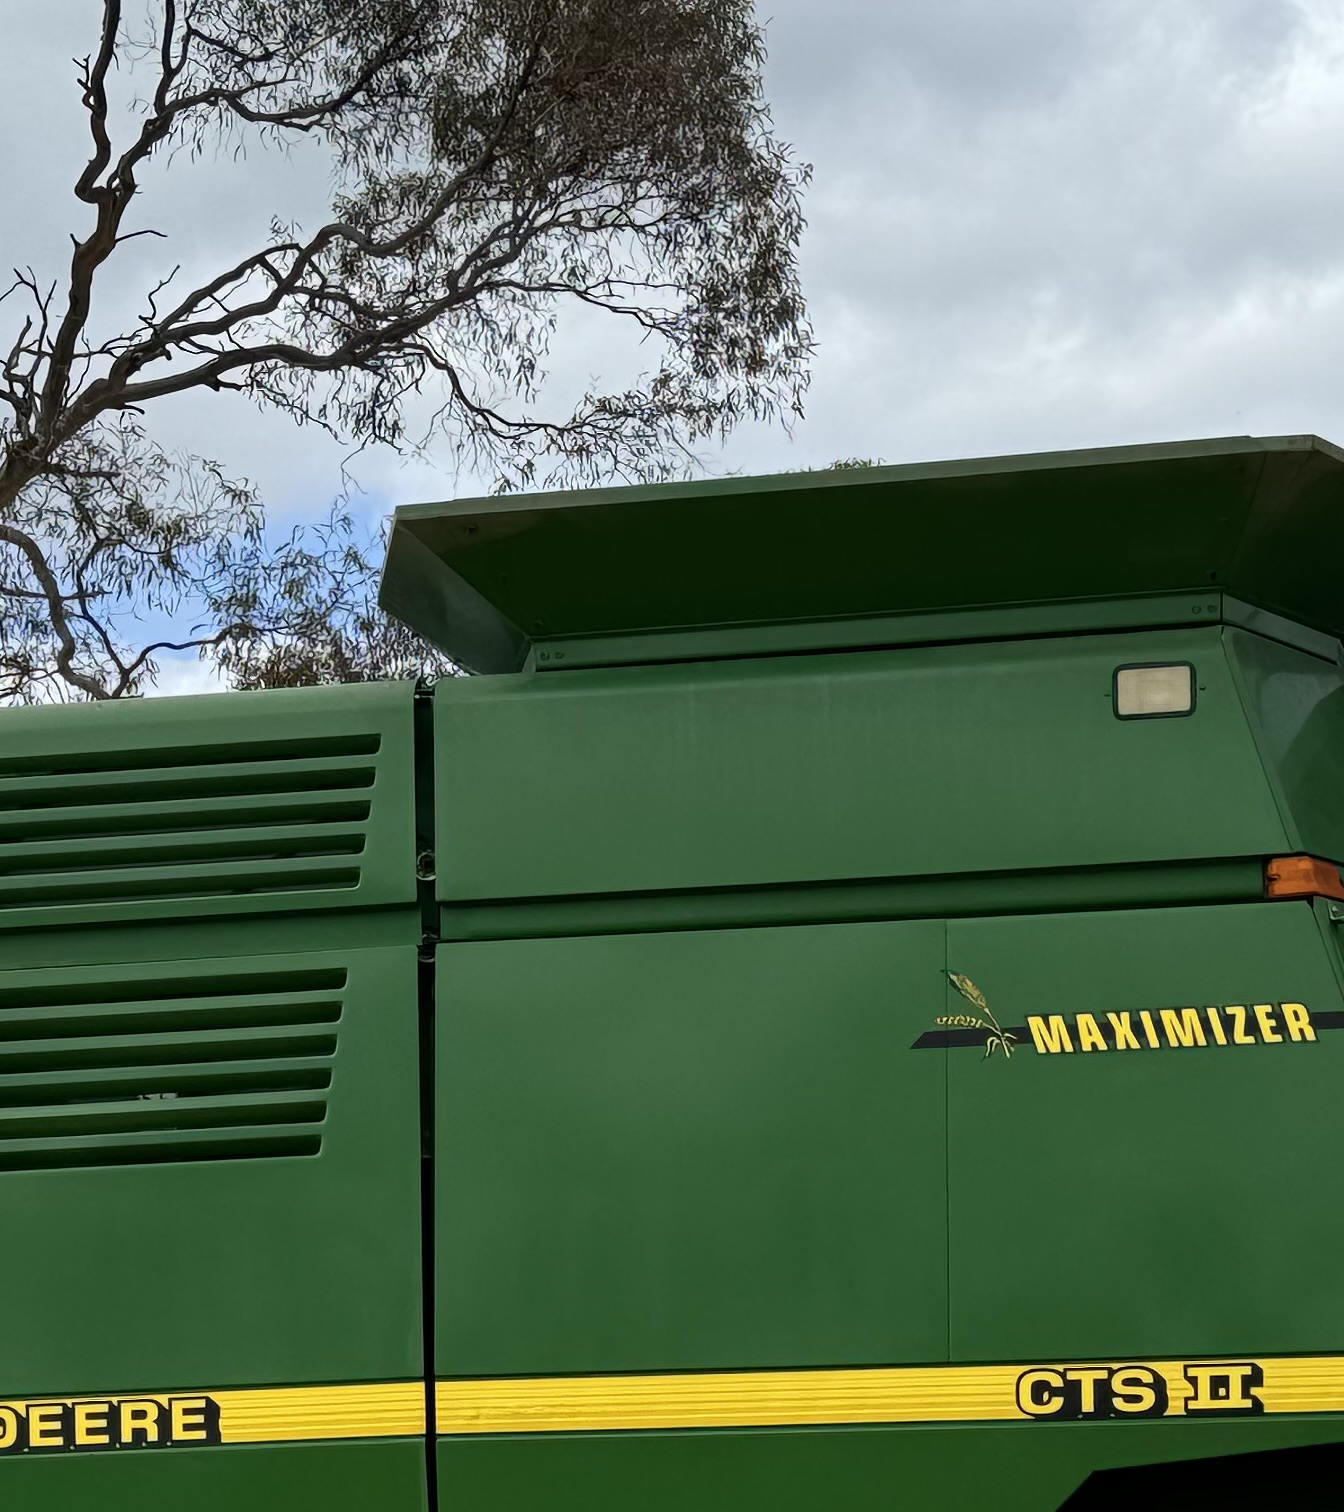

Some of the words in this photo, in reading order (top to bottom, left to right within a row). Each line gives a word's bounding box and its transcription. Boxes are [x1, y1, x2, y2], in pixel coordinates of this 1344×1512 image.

[1027, 1003, 1317, 1055] MAXIMIZER
[1017, 1367, 1163, 1418] CTS
[1185, 1364, 1259, 1414] II
